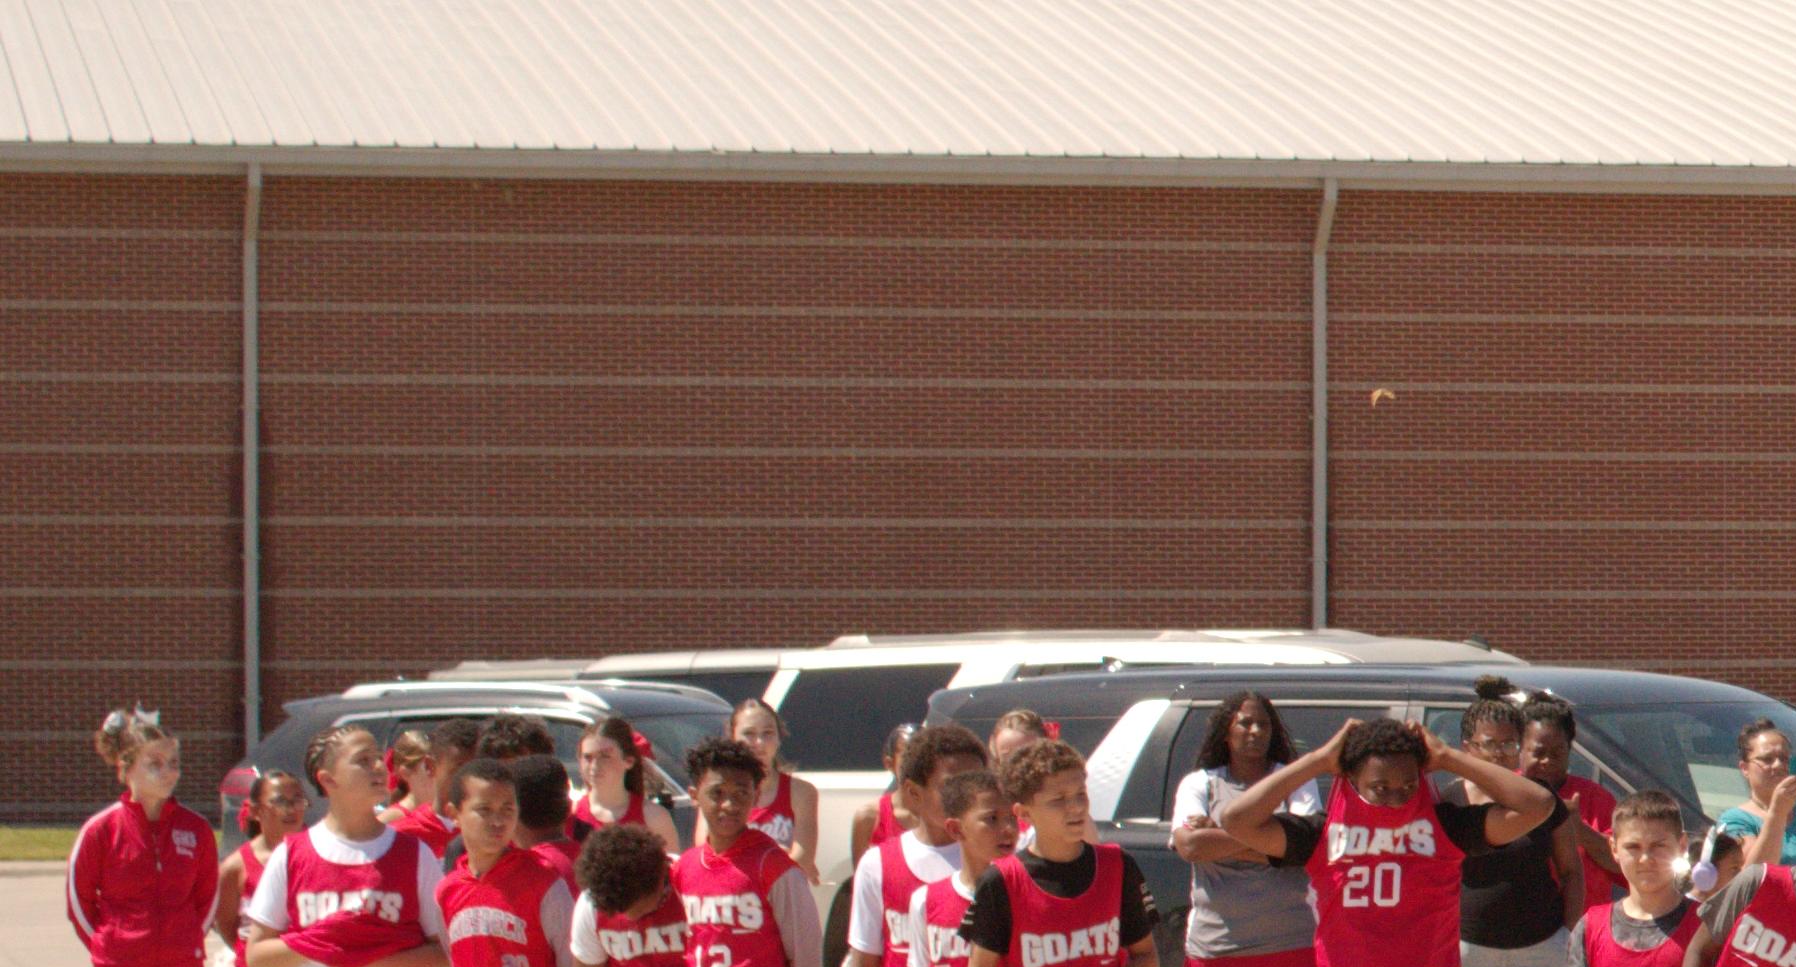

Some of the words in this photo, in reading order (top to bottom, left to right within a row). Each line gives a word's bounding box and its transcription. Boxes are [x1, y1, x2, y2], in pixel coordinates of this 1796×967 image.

[1327, 818, 1437, 862] GOATS
[1342, 861, 1402, 908] 20
[296, 888, 405, 928] GOATS
[682, 891, 764, 930] OATS
[599, 923, 692, 961] GOAT
